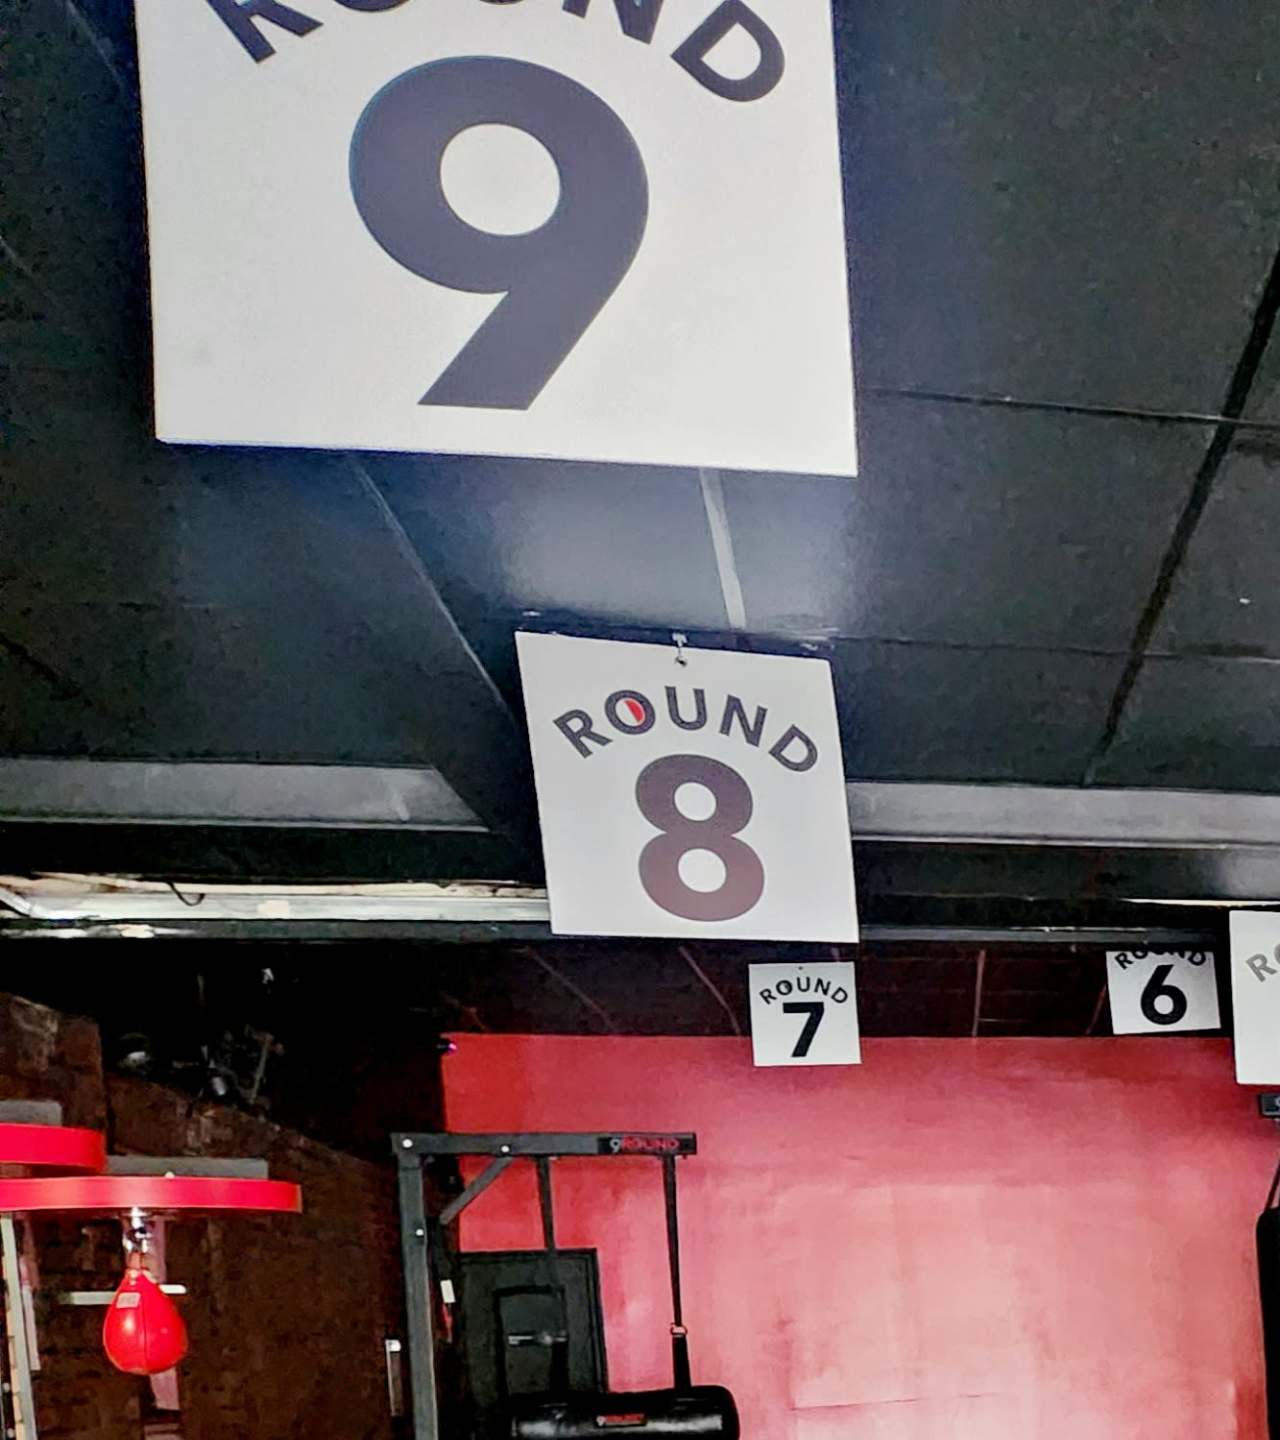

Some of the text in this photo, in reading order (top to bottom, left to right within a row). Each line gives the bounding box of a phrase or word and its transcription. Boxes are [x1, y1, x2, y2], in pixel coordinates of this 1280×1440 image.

[349, 54, 650, 411] 9
[552, 685, 819, 773] ROUND
[635, 753, 765, 922] 8
[758, 976, 849, 1005] ROUND
[1140, 964, 1188, 1026] 6
[782, 1001, 825, 1058] 7
